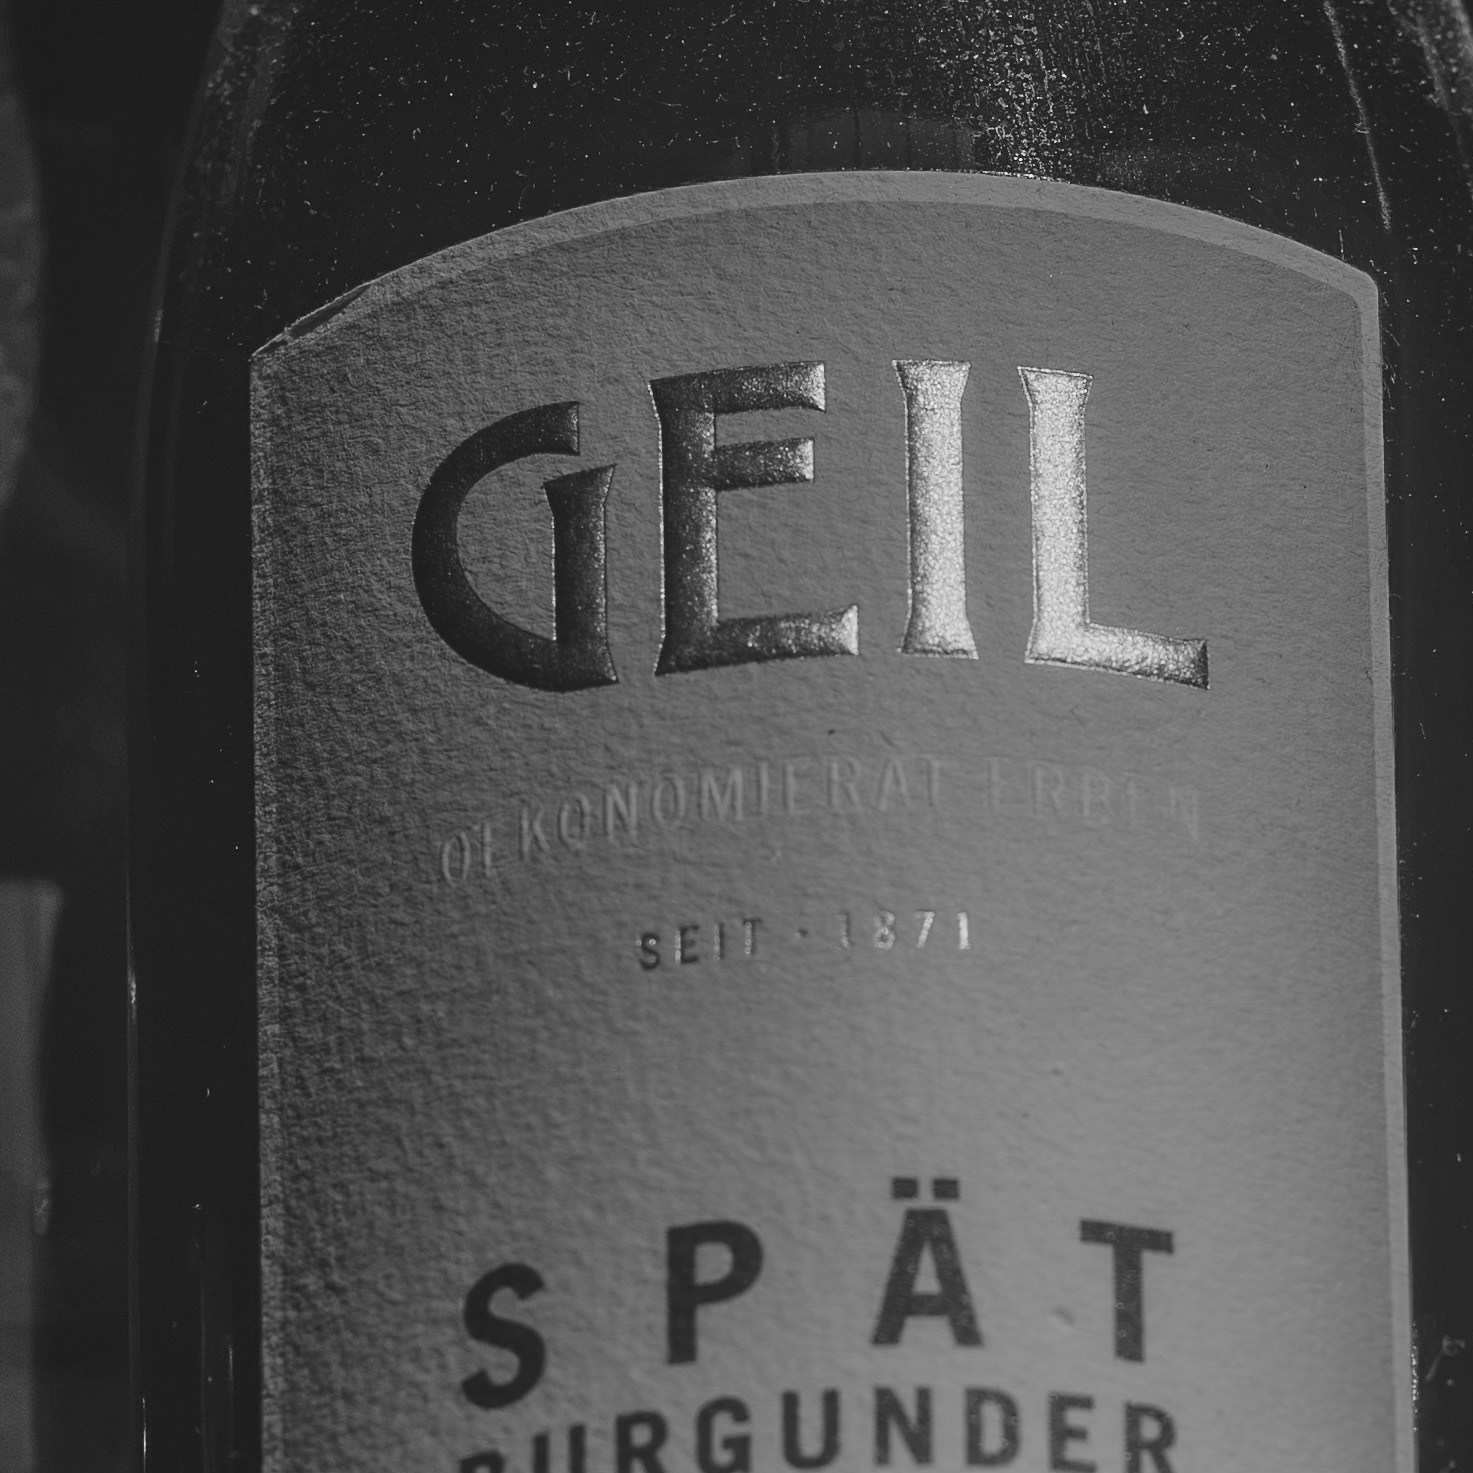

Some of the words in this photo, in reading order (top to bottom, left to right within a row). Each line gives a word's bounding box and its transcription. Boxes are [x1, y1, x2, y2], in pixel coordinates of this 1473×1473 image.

[411, 361, 1208, 693] GEIL
[439, 759, 945, 887] OEKONOMIERAT
[985, 758, 1198, 840] ERBEN
[638, 916, 761, 970] SEIT
[836, 911, 971, 953] 1871
[461, 1177, 1176, 1409] SPÄT
